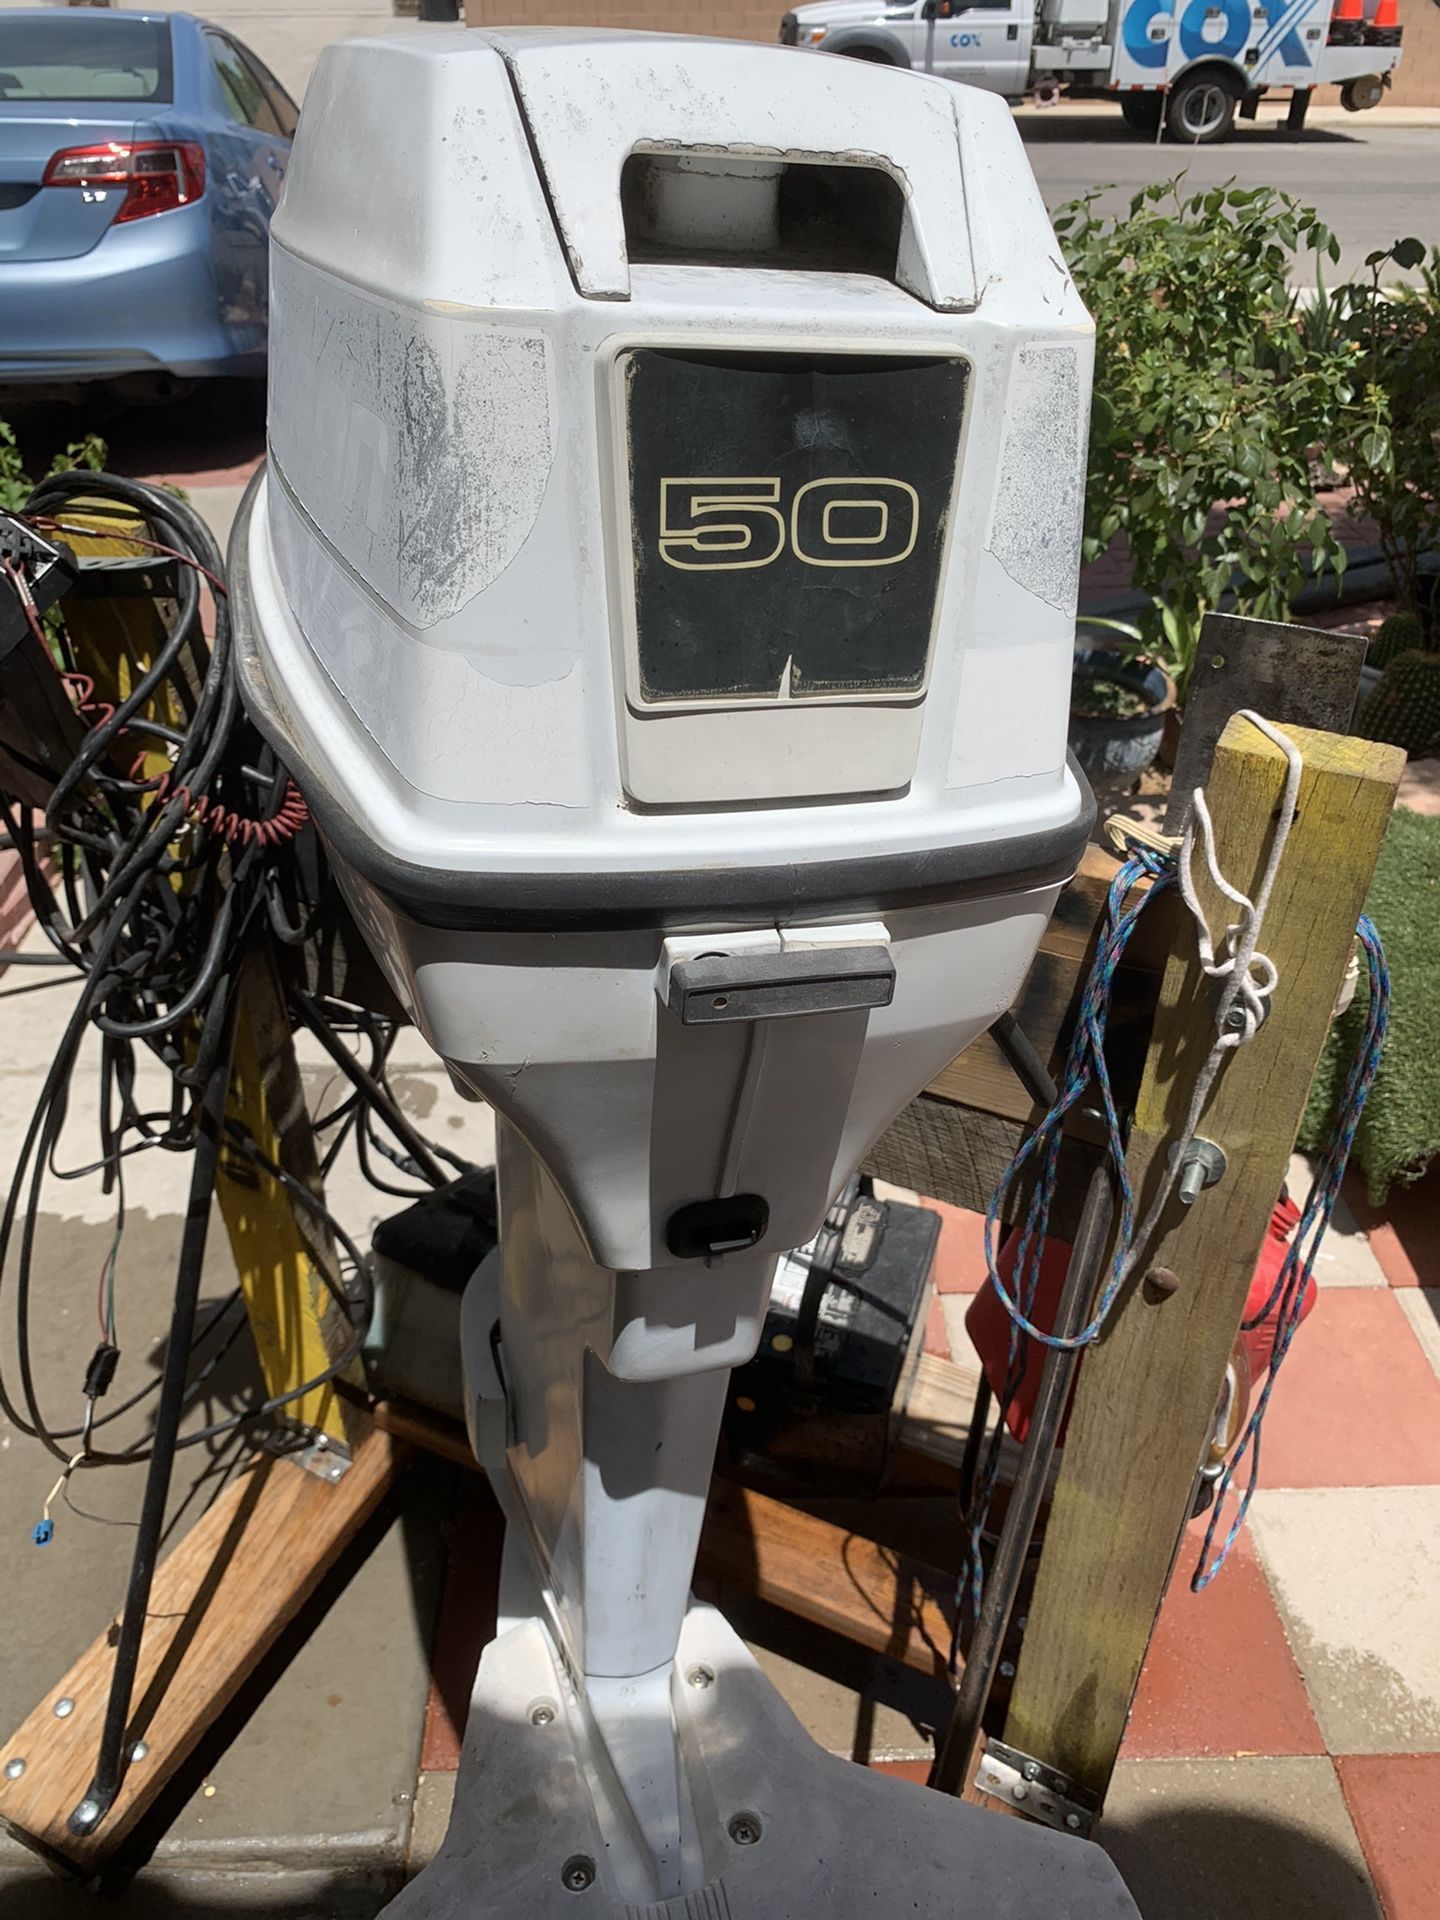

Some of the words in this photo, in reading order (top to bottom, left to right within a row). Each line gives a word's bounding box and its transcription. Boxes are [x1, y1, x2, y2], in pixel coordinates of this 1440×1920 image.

[951, 33, 981, 48] COX
[1122, 0, 1318, 68] COX
[658, 477, 919, 571] 50
